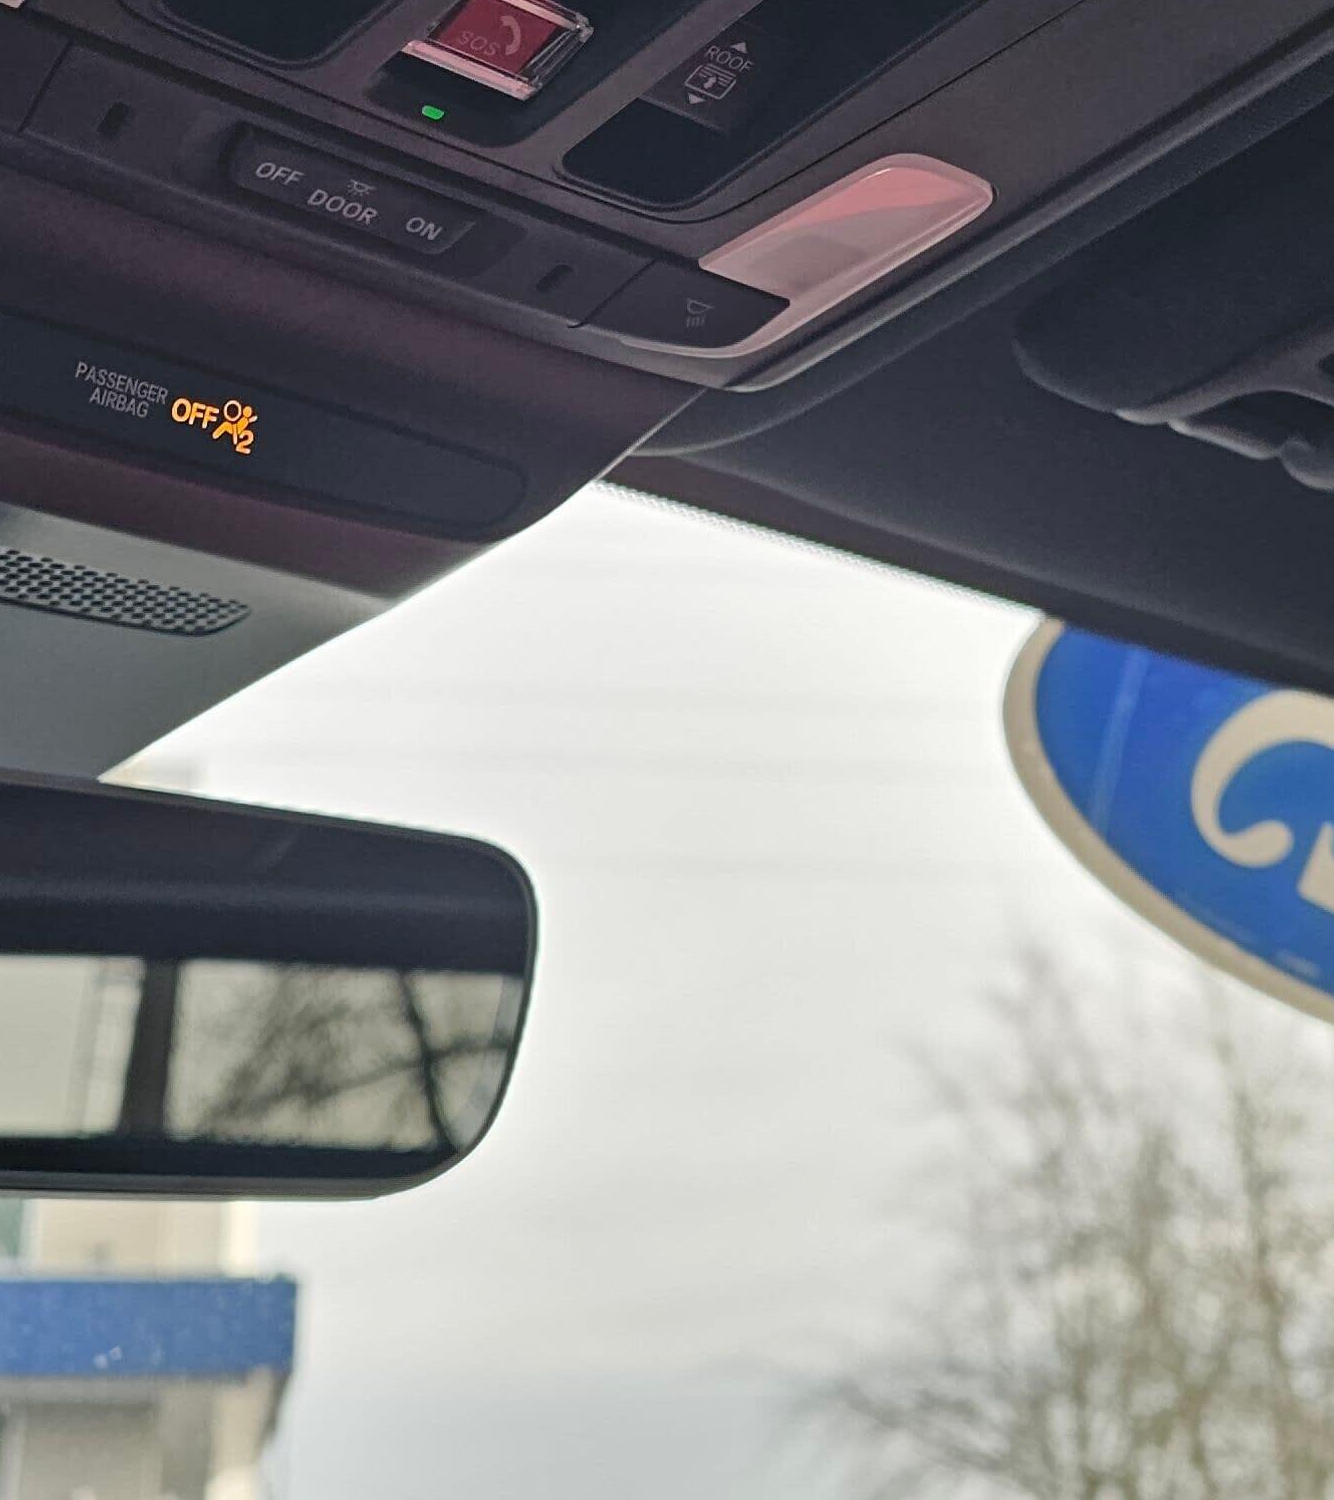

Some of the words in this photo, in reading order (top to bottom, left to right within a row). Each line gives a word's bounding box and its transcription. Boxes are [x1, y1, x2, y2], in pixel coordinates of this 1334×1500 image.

[457, 30, 501, 57] SOS
[704, 45, 755, 73] ROOF
[255, 162, 304, 185] OFF
[307, 189, 378, 225] DOOR
[405, 217, 443, 241] ON
[75, 362, 168, 404] PASSENGER
[89, 388, 149, 418] AIRBAG
[171, 398, 219, 429] OFF
